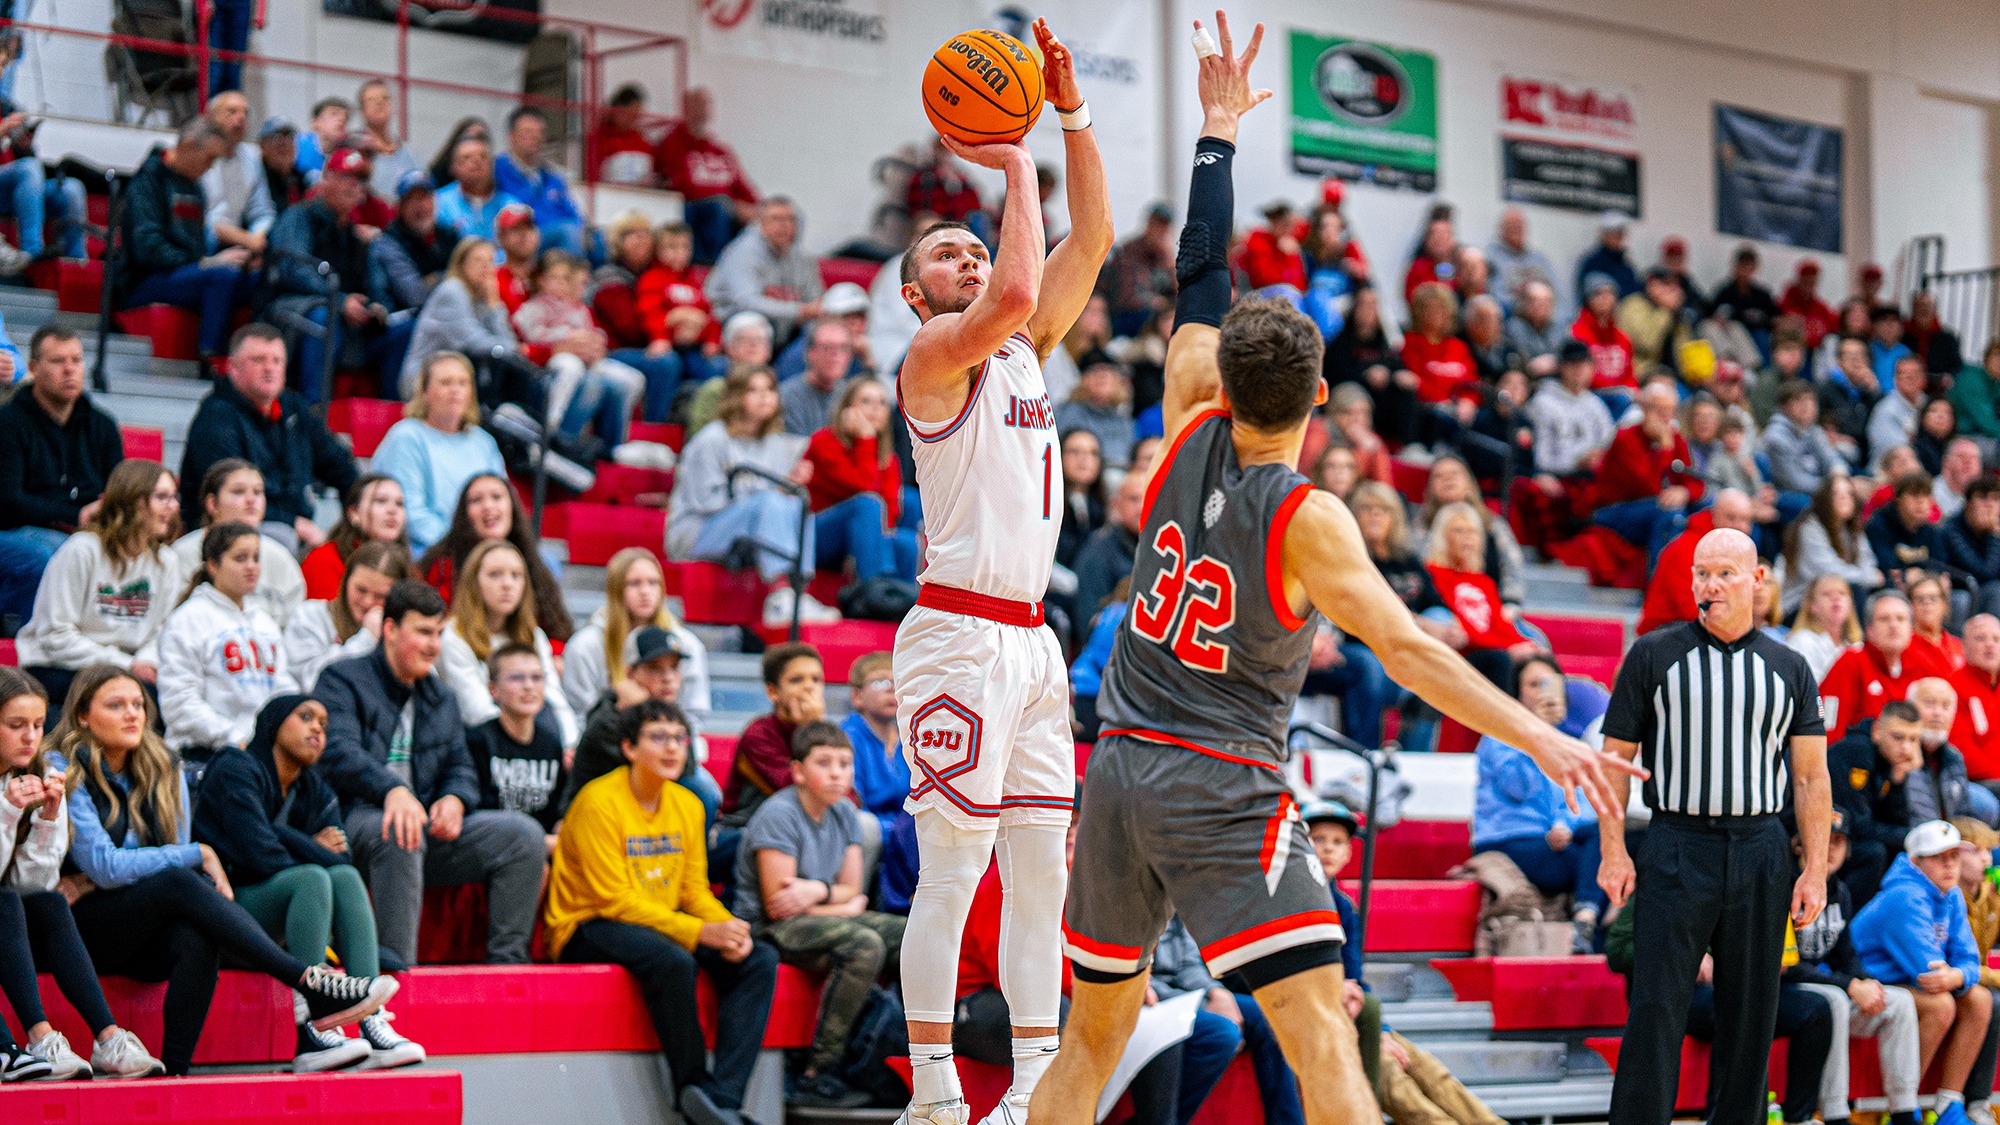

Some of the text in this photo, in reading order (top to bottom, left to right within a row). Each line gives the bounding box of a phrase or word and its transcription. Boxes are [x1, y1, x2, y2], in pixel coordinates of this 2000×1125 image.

[938, 85, 960, 106] SJU
[947, 40, 1010, 97] Wilson
[1041, 442, 1051, 520] 1
[1130, 520, 1237, 674] 32
[919, 728, 965, 753] SJU
